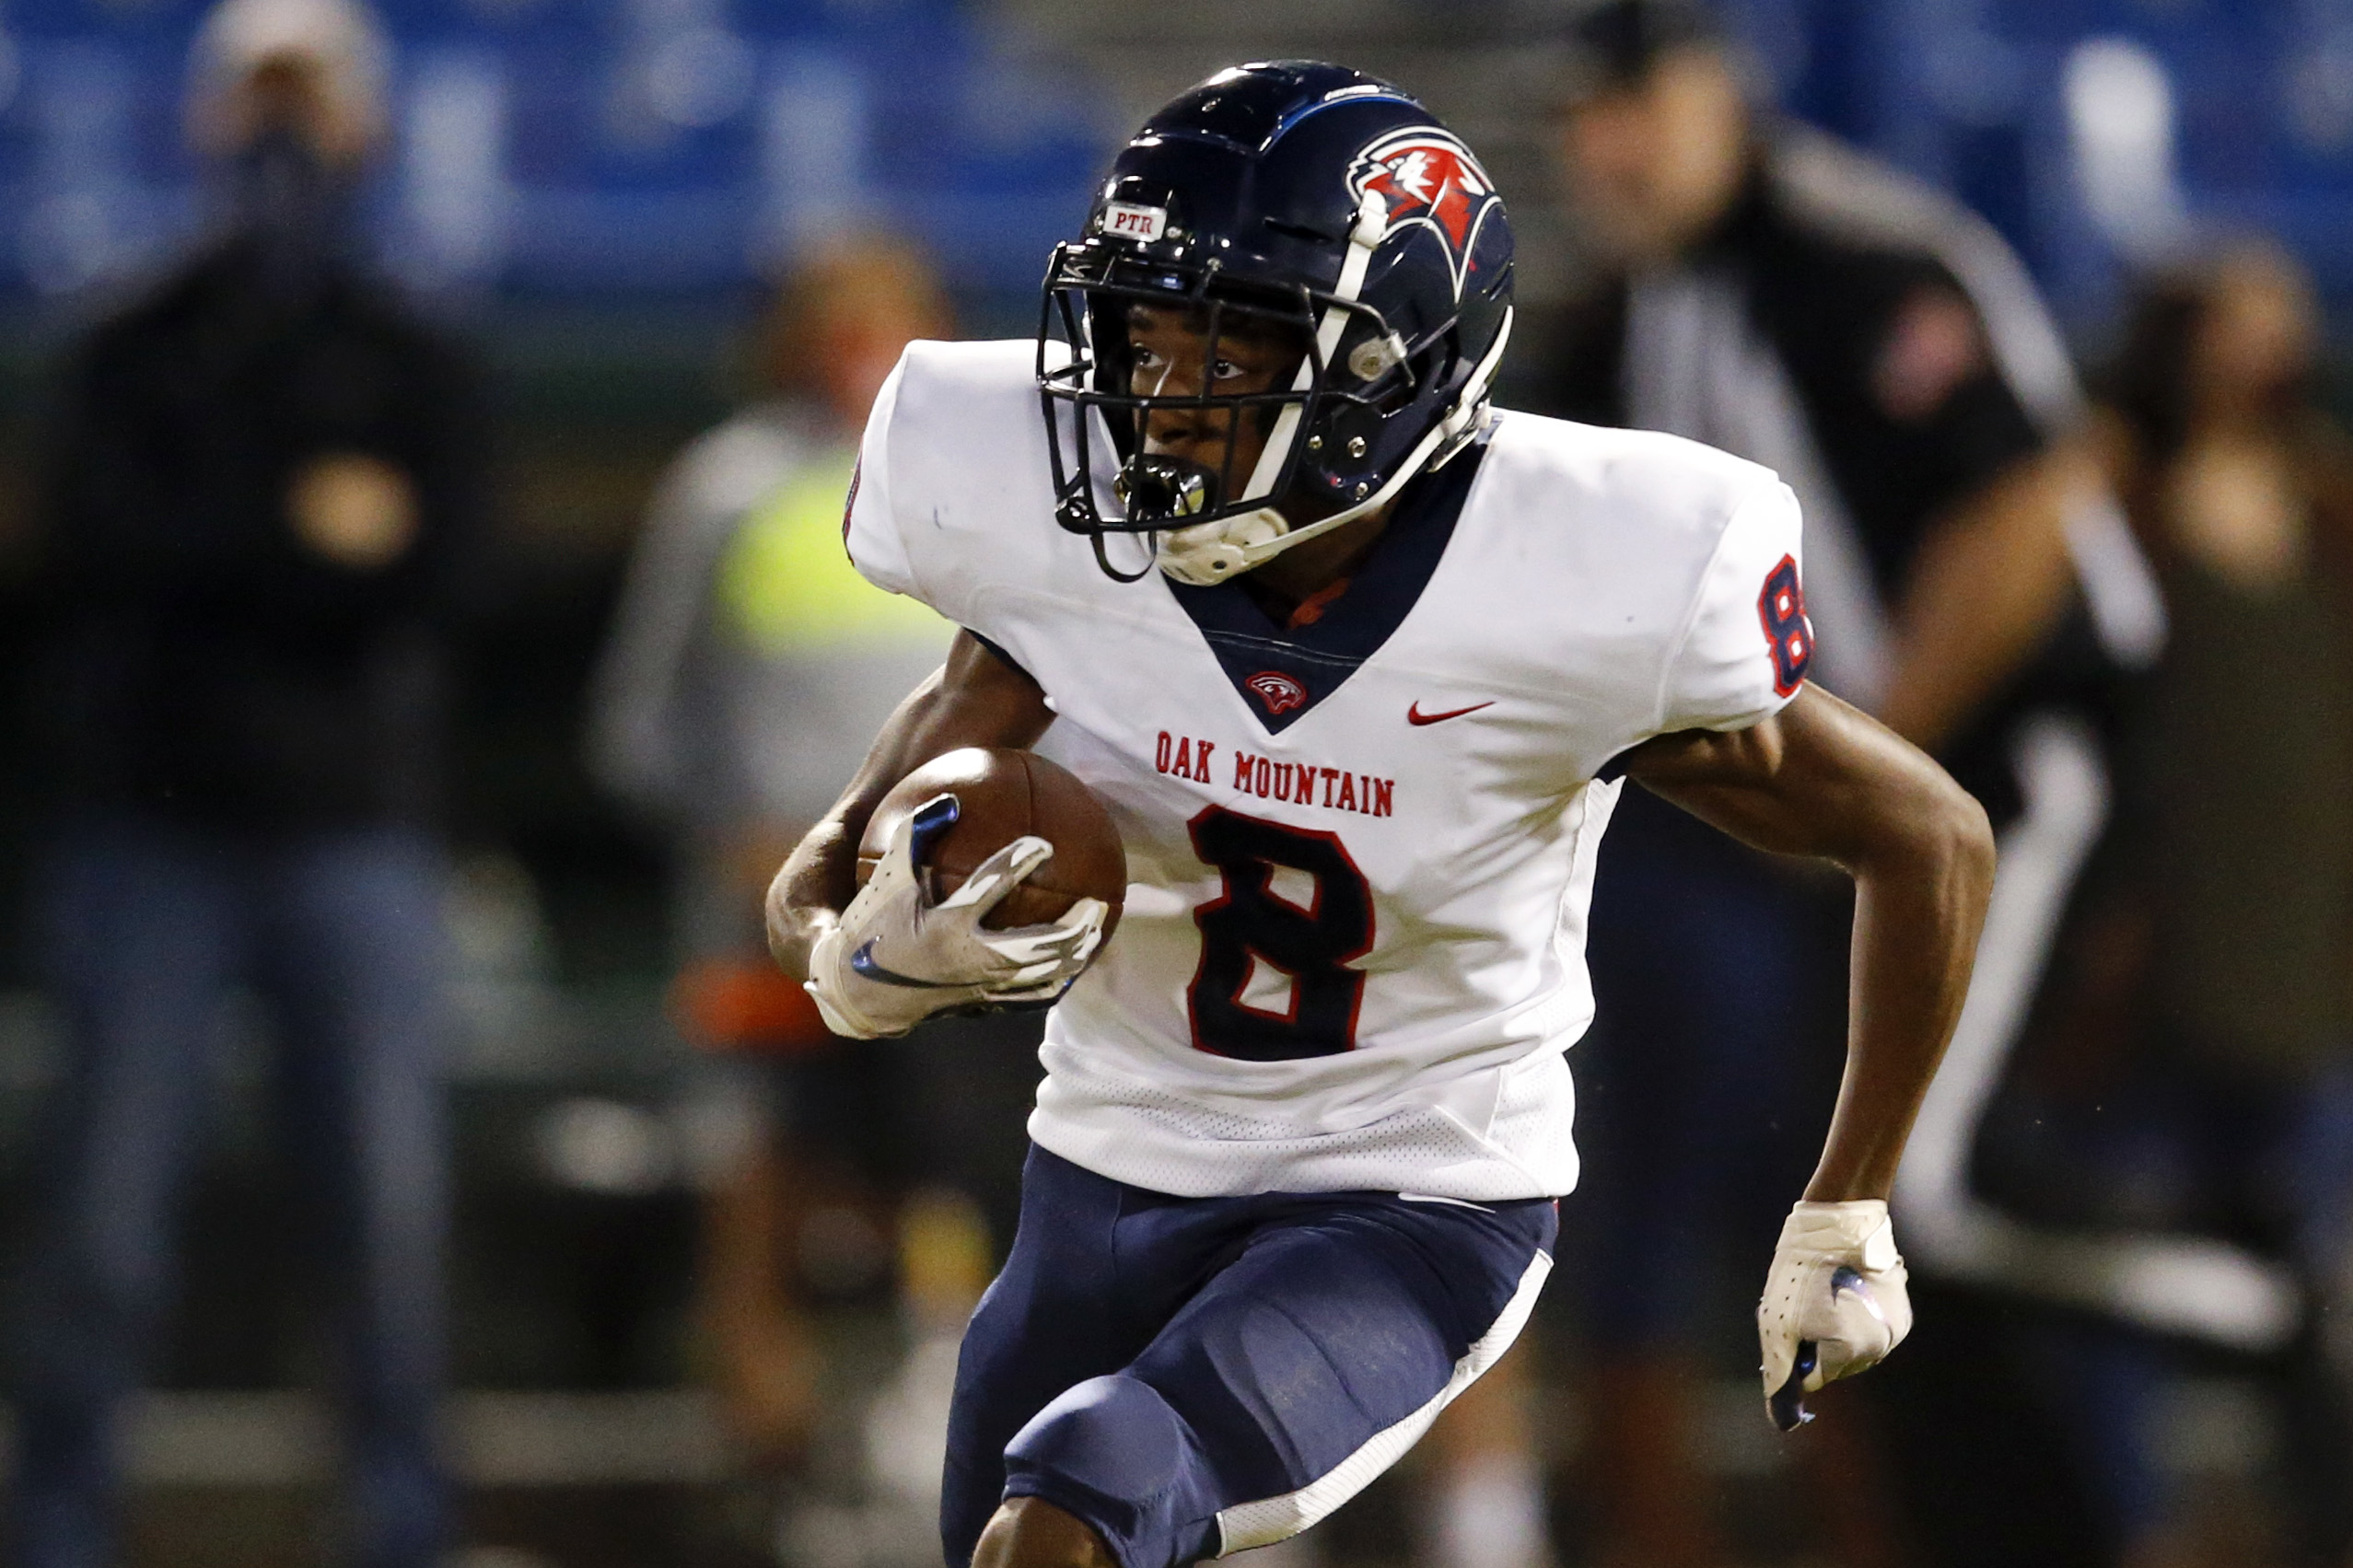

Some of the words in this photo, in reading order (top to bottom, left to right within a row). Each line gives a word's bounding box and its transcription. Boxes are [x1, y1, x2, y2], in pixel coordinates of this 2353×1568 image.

[1114, 212, 1153, 234] PTR
[1757, 552, 1814, 698] 8
[1156, 731, 1214, 783] OAK
[1233, 750, 1394, 817] MOUNTAIN
[1187, 803, 1376, 1063] 8
